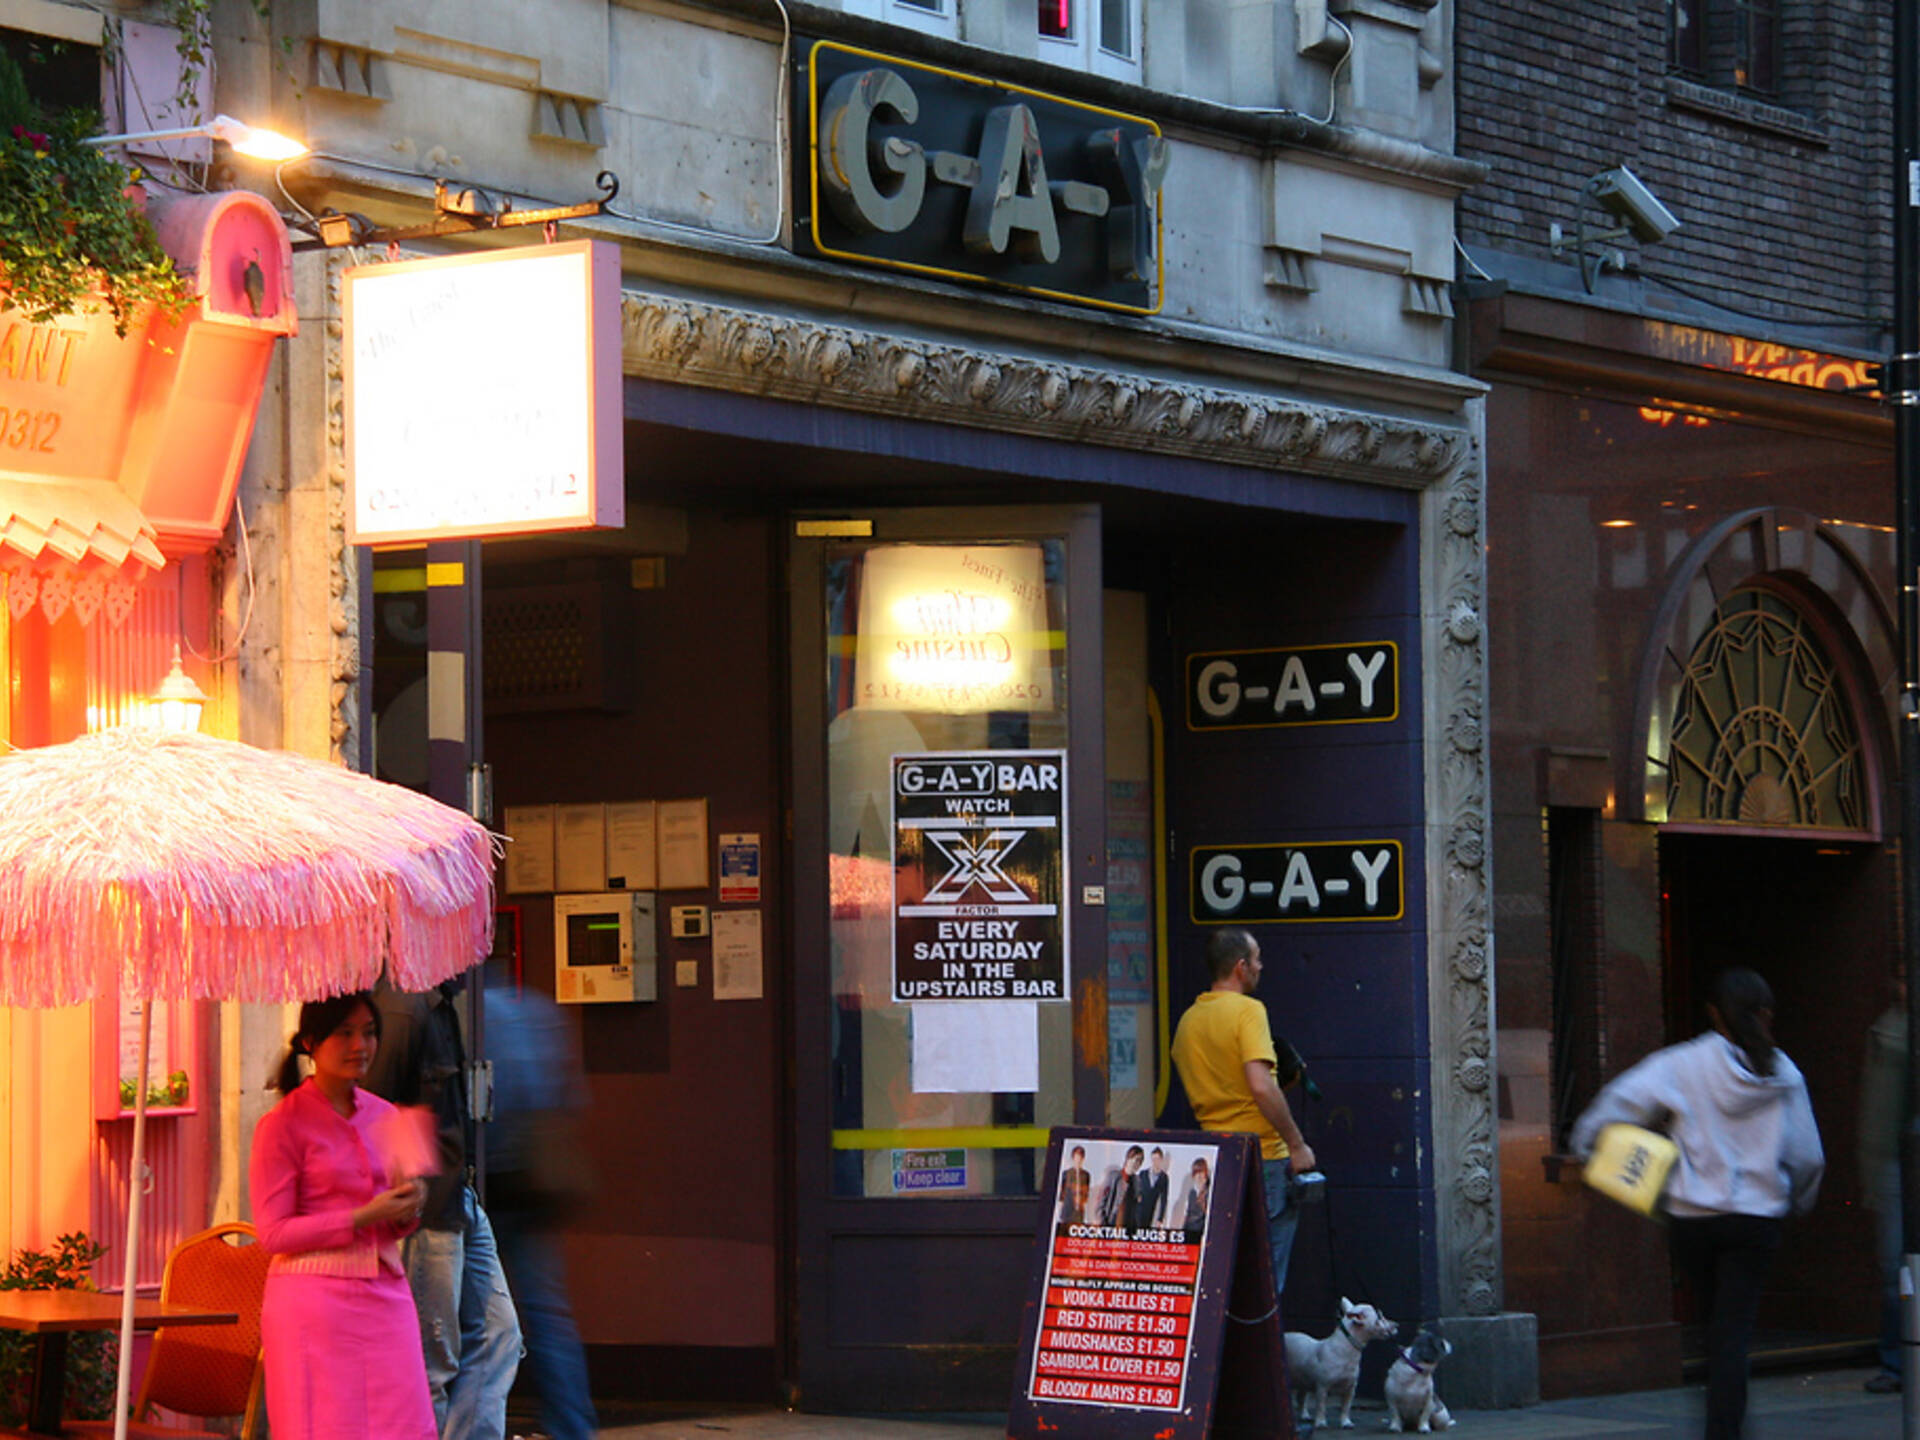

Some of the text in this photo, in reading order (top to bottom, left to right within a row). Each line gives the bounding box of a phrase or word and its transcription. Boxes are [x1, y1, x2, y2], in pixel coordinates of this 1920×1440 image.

[819, 68, 1171, 284] G-A-Y
[1197, 651, 1386, 717] G-A-Y
[902, 765, 1058, 792] G-A-Y BAR
[945, 799, 1010, 813] WATCH
[1201, 849, 1391, 911] G-A-Y
[955, 906, 999, 915] FACTOR
[938, 921, 1018, 939] EVERY
[914, 942, 1043, 960] SATURDAY
[943, 963, 1015, 978] IN THE
[901, 981, 1056, 997] UPSTAIRS BAR
[908, 1169, 961, 1187] Keep clear
[1069, 1224, 1185, 1243] COCKTAIL JUGS £5
[1131, 1242, 1168, 1252] COCKTAIL
[1122, 1263, 1160, 1273] COCKTAIL
[1050, 1278, 1075, 1287] WHEN
[1104, 1281, 1136, 1291] APPEAR
[1137, 1284, 1151, 1292] ON
[1063, 1290, 1175, 1312] VODKA JELLIES £1
[1057, 1310, 1176, 1333] RED STRIPE £1.50
[1050, 1332, 1175, 1356] MUDSHAKES £1.50
[1040, 1351, 1100, 1370] SAMBUCA
[1103, 1357, 1142, 1374] LOVER
[1145, 1361, 1181, 1377] £1.50
[1039, 1380, 1173, 1404] BLOODY MARYS £1.50
